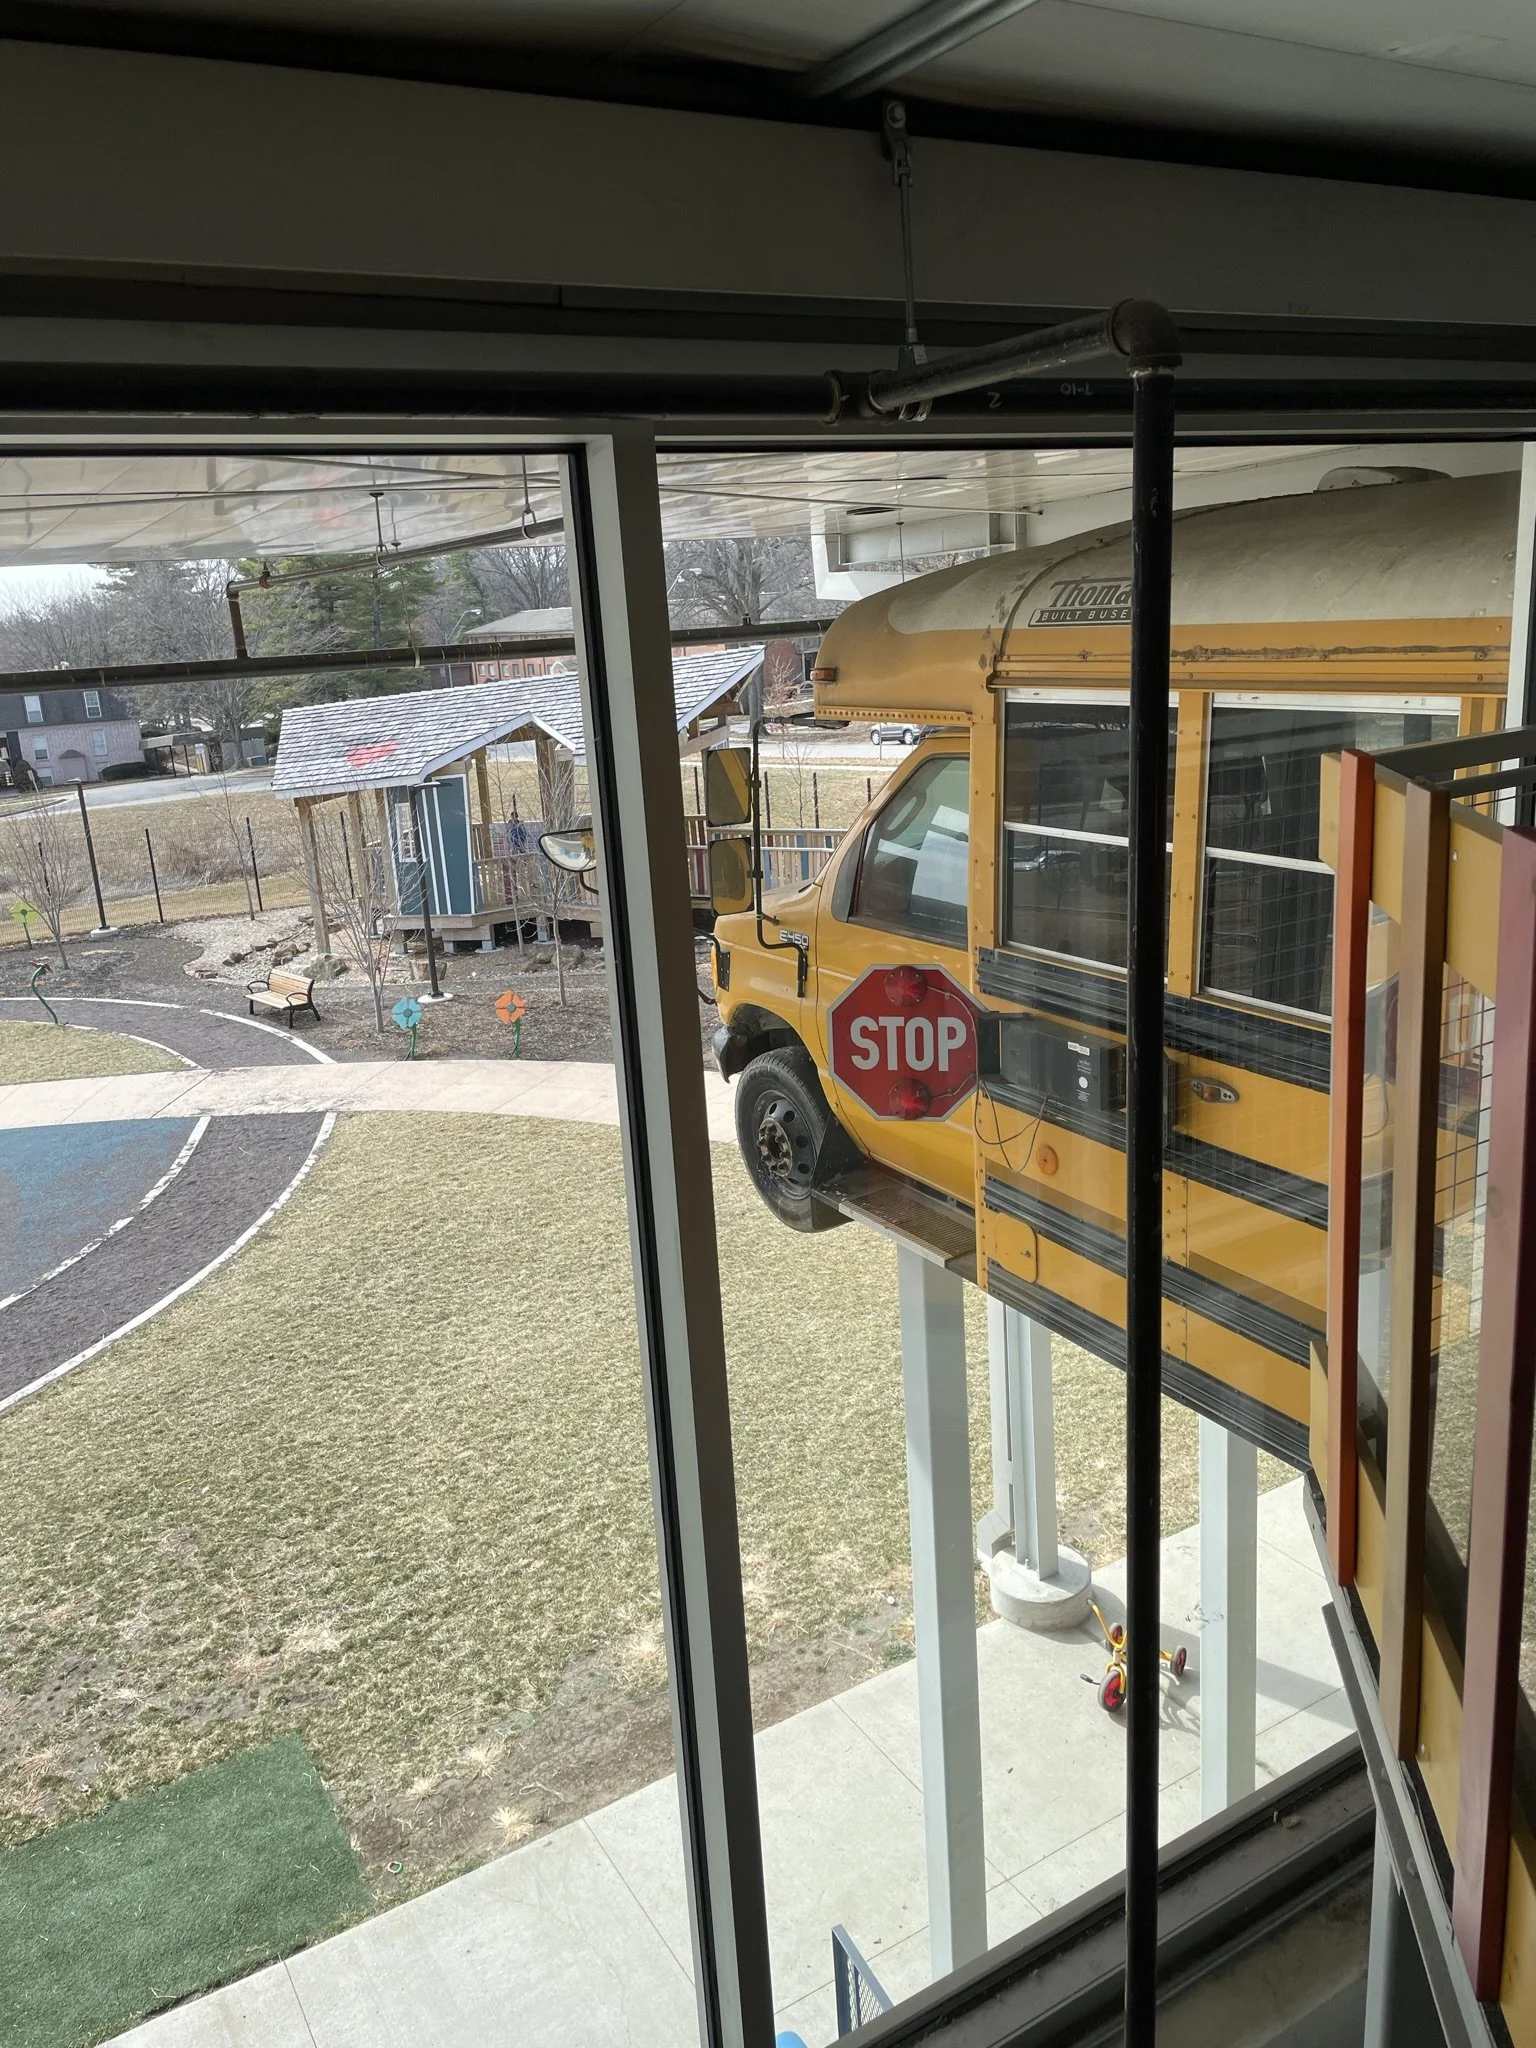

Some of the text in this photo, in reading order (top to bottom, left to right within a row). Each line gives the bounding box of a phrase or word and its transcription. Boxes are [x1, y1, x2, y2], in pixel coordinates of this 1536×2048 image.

[1049, 575, 1132, 608] Thoma
[1041, 609, 1128, 621] BUILT BUSE
[779, 929, 809, 947] E450
[850, 1015, 967, 1072] STOP
